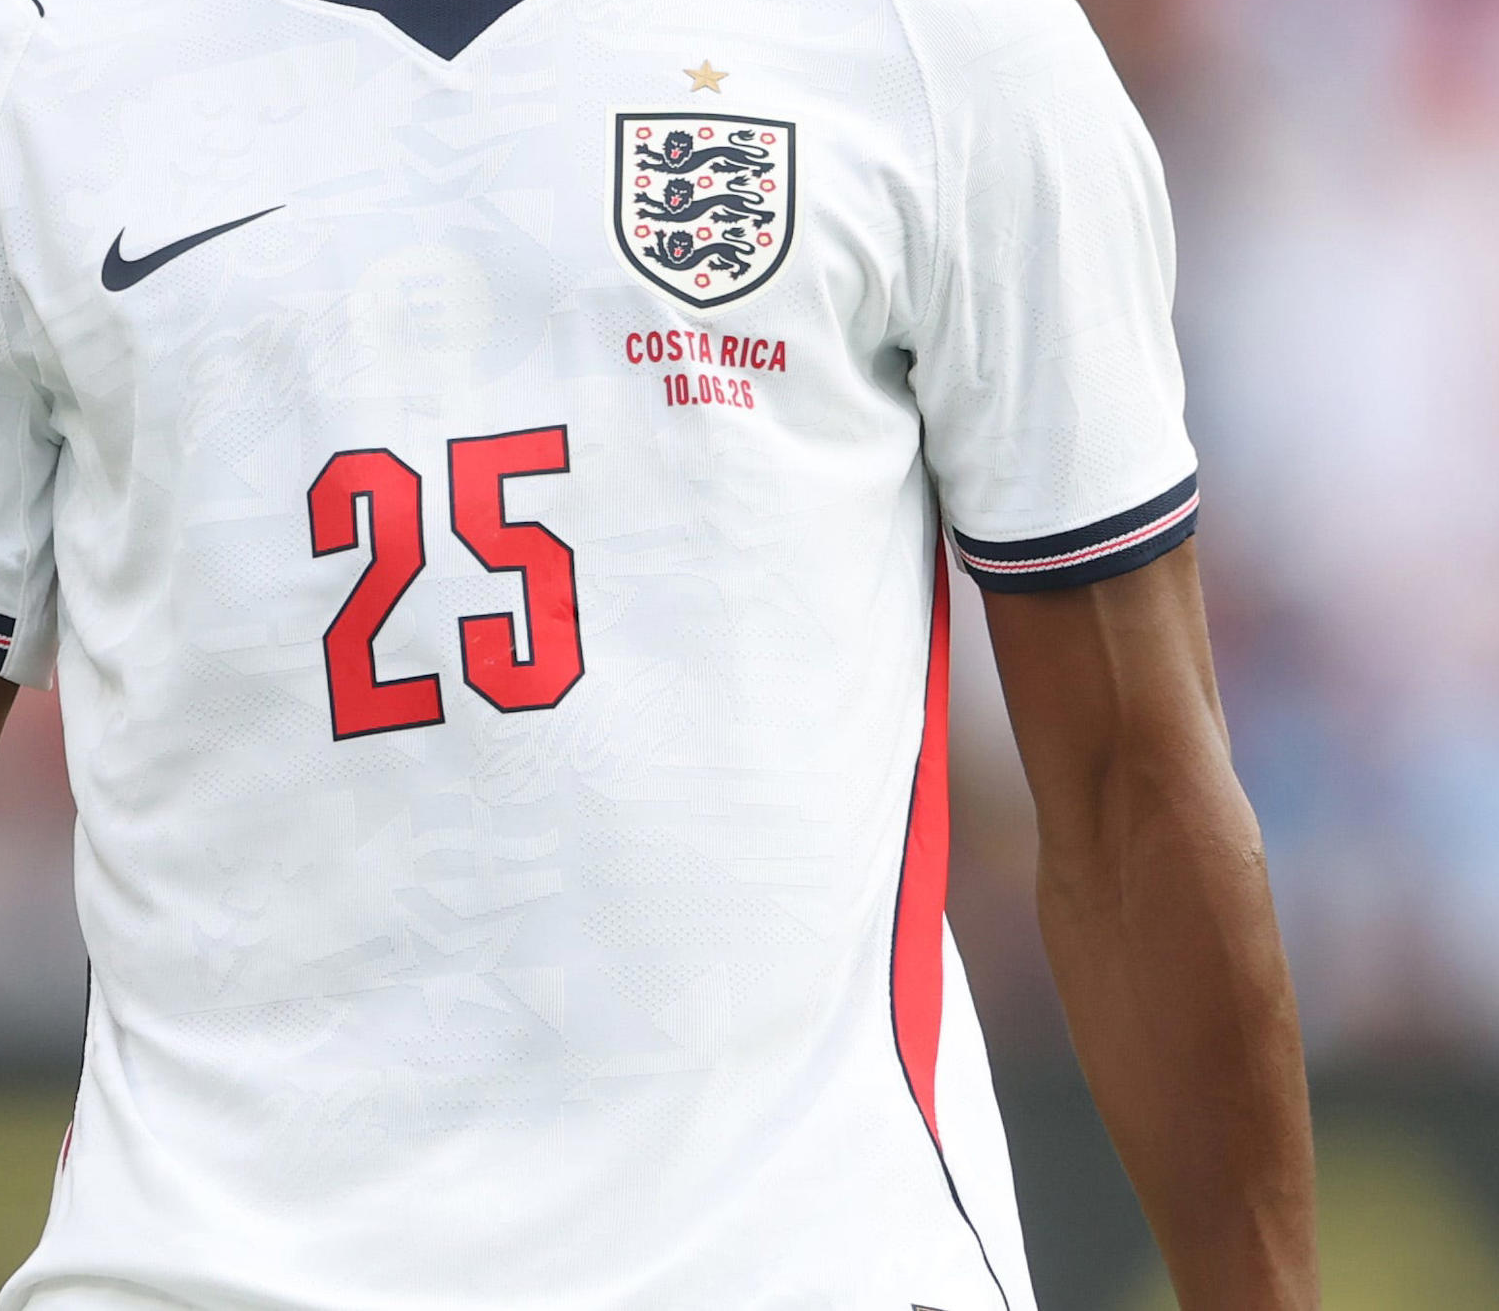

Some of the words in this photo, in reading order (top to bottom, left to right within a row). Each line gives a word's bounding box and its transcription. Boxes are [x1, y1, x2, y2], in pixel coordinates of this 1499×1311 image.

[626, 330, 712, 364] COSTA
[721, 336, 786, 372] RICA
[663, 374, 754, 409] 10.06.26
[307, 424, 585, 741] 25
